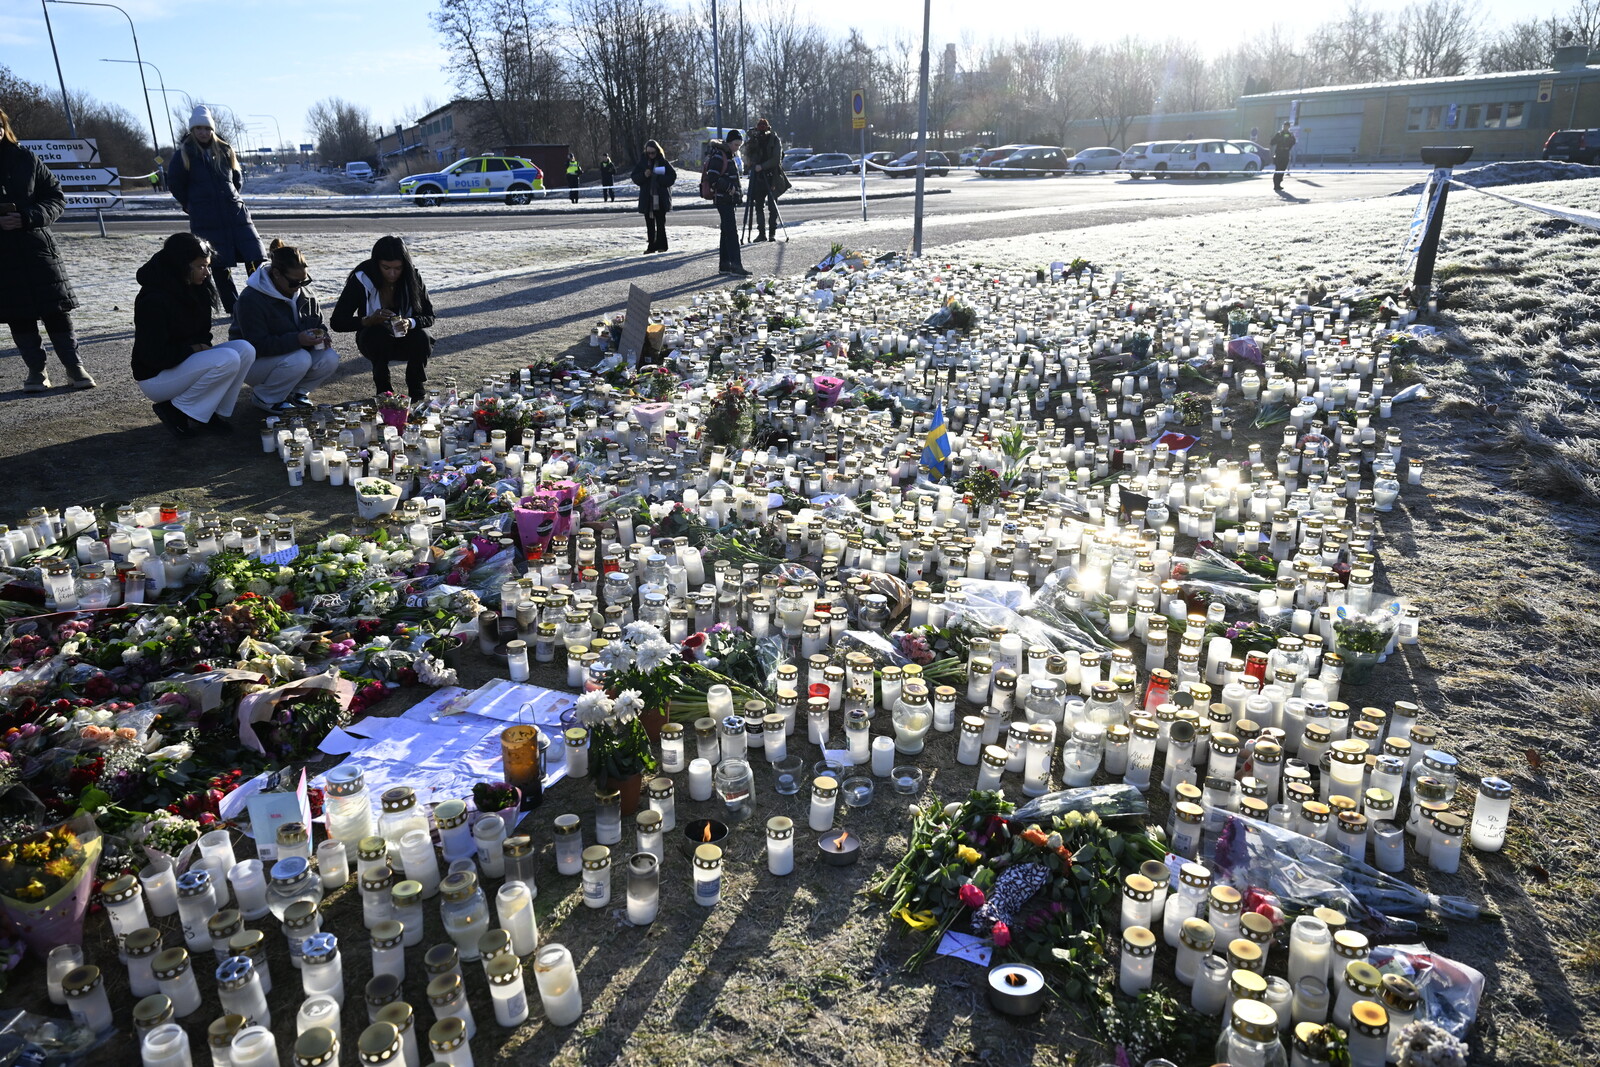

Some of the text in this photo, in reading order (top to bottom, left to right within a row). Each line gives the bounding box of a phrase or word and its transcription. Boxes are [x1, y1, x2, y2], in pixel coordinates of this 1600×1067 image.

[20, 143, 84, 151] vux Campus
[38, 153, 62, 161] gska
[54, 173, 97, 181] låmesen
[65, 196, 107, 204] skolan
